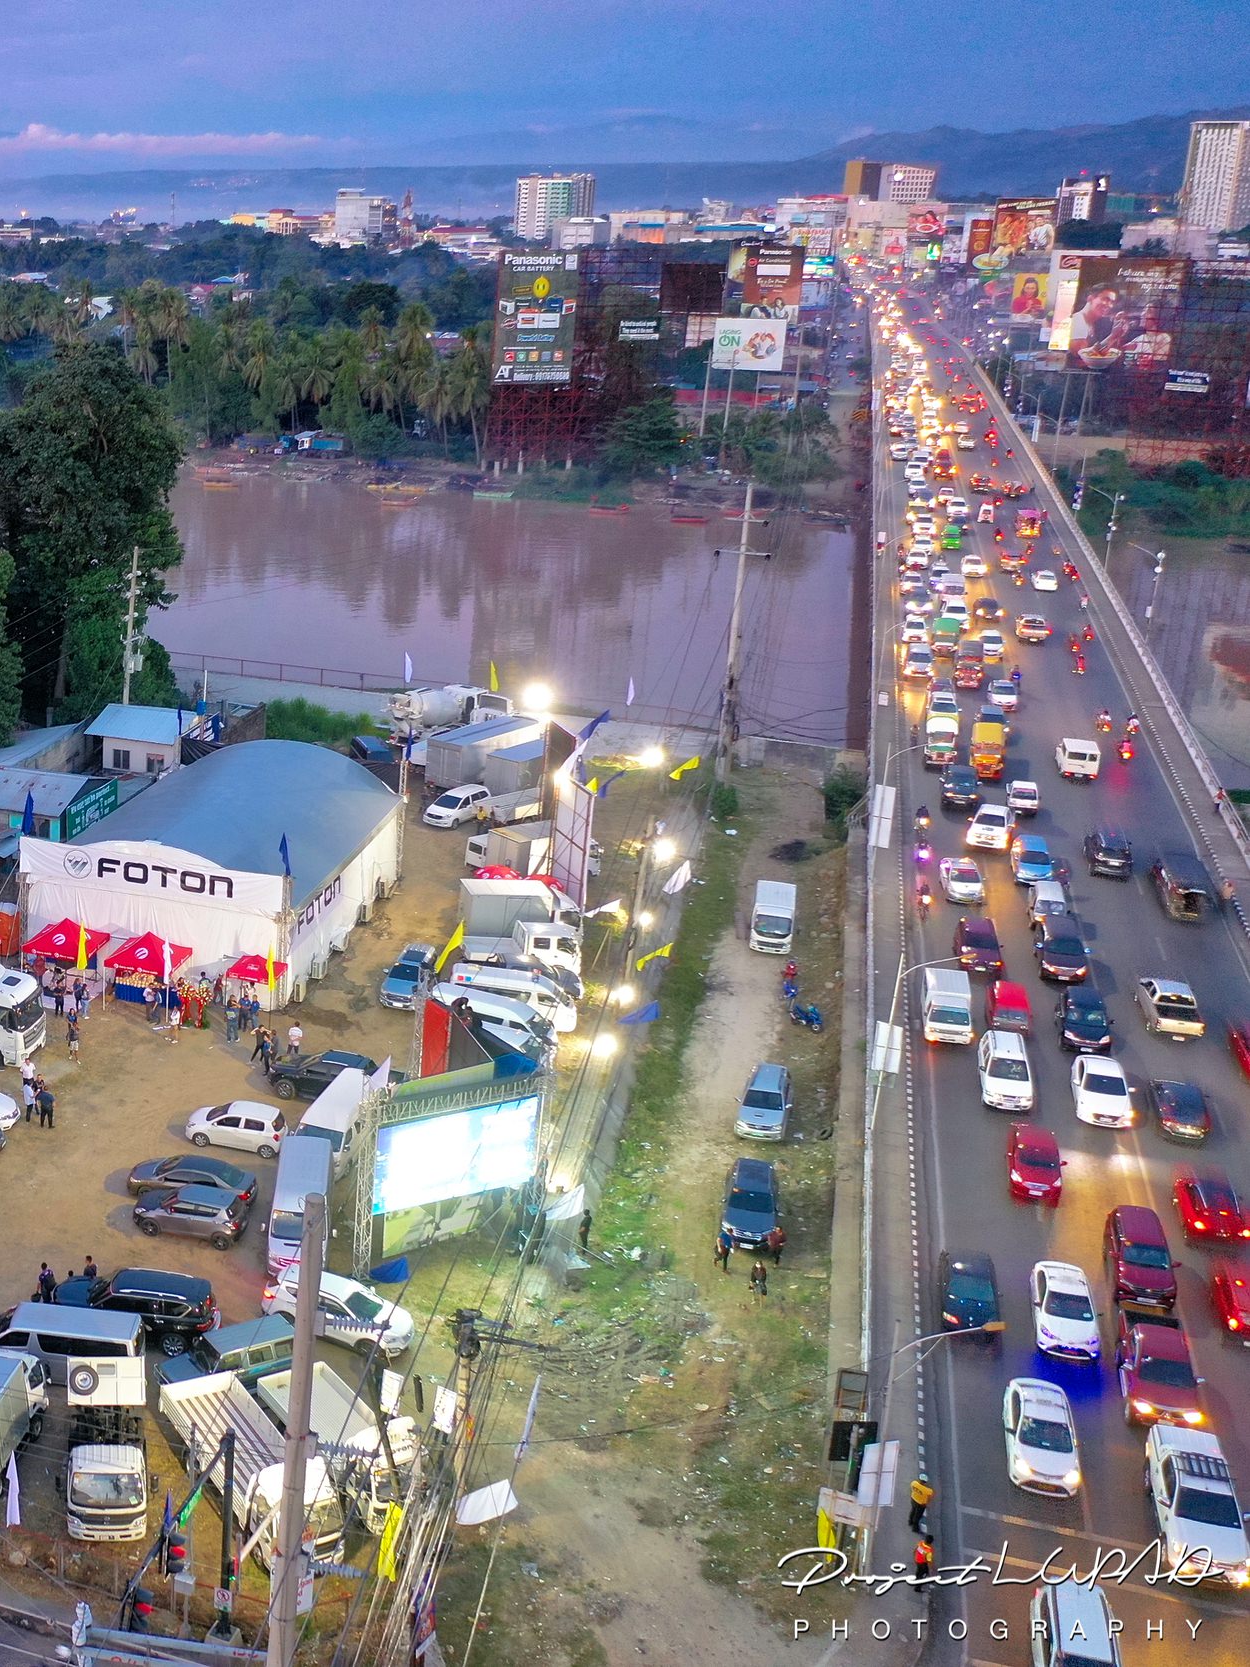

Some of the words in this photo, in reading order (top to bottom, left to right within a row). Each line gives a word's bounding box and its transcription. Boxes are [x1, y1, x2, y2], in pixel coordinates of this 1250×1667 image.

[505, 253, 563, 265] Panasonic
[719, 335, 740, 347] ON
[97, 857, 233, 898] FOTON
[297, 875, 341, 935] FOTON
